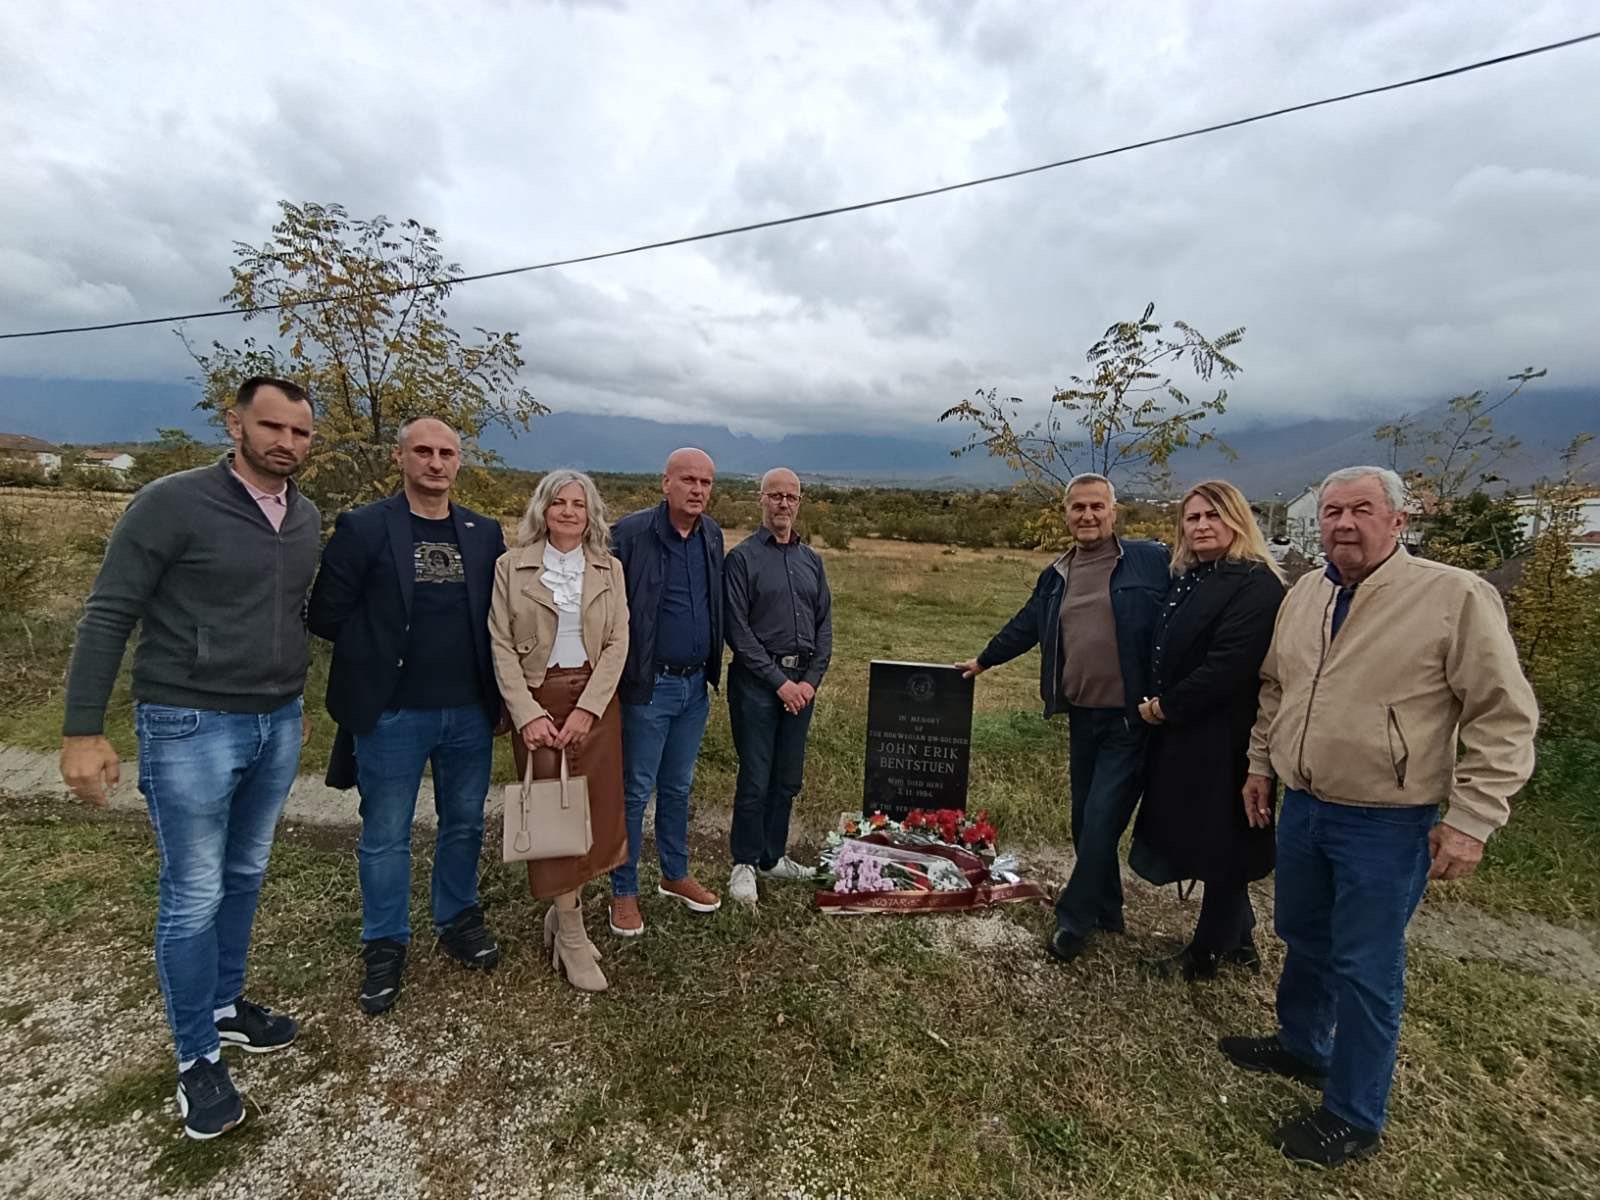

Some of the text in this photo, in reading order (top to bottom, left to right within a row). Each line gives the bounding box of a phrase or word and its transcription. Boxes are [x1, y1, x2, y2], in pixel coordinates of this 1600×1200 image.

[878, 742, 959, 760] JOHN ERIK
[880, 757, 954, 774] BENTSTUEN
